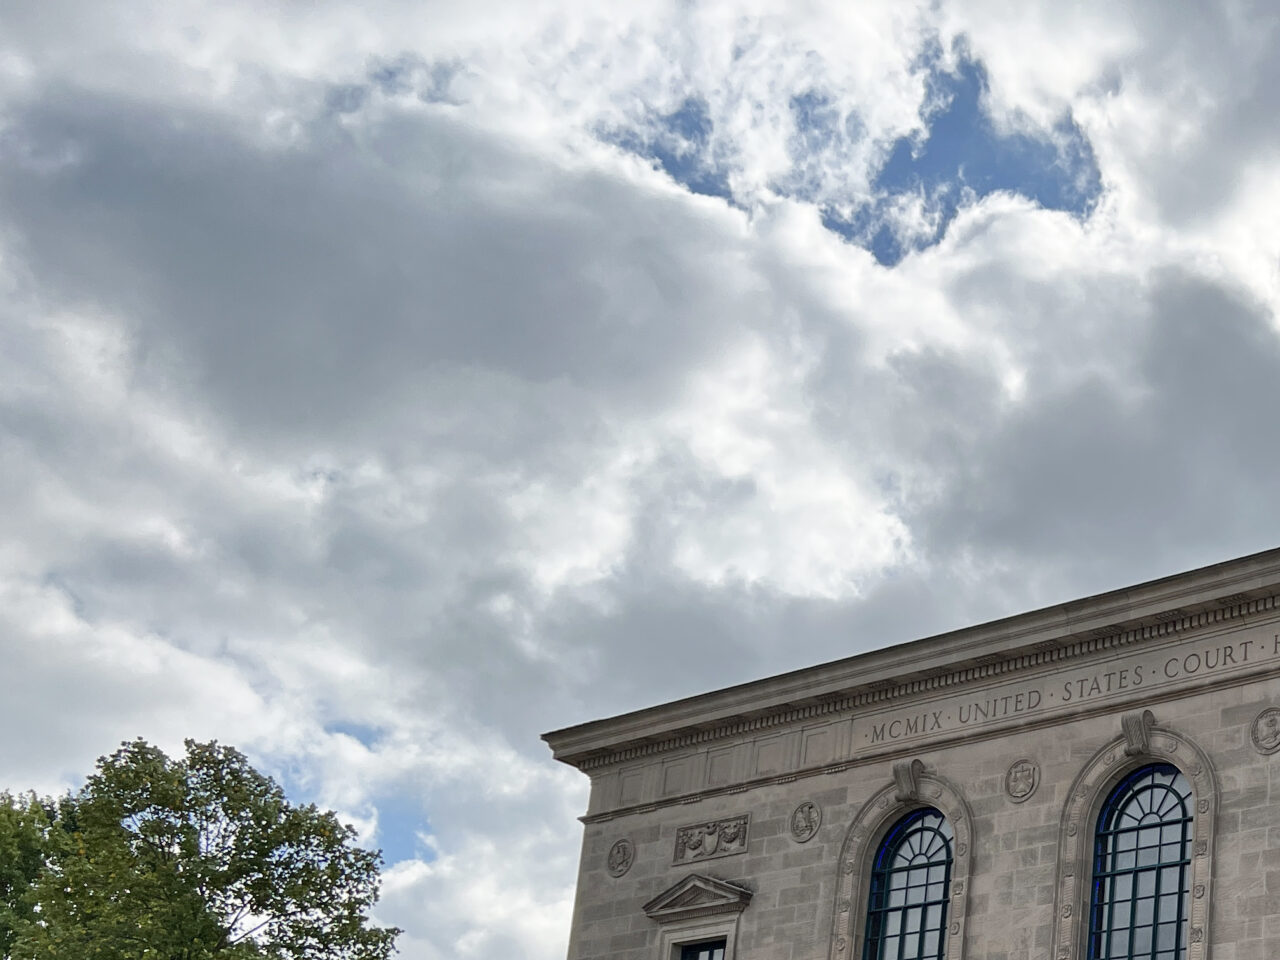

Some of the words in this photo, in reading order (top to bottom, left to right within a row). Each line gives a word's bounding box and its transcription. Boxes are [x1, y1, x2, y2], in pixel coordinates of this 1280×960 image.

[872, 710, 944, 741] MCMIX
[958, 690, 1042, 724] UNITED
[1061, 664, 1144, 702] STATES
[1163, 640, 1254, 679] COURT
